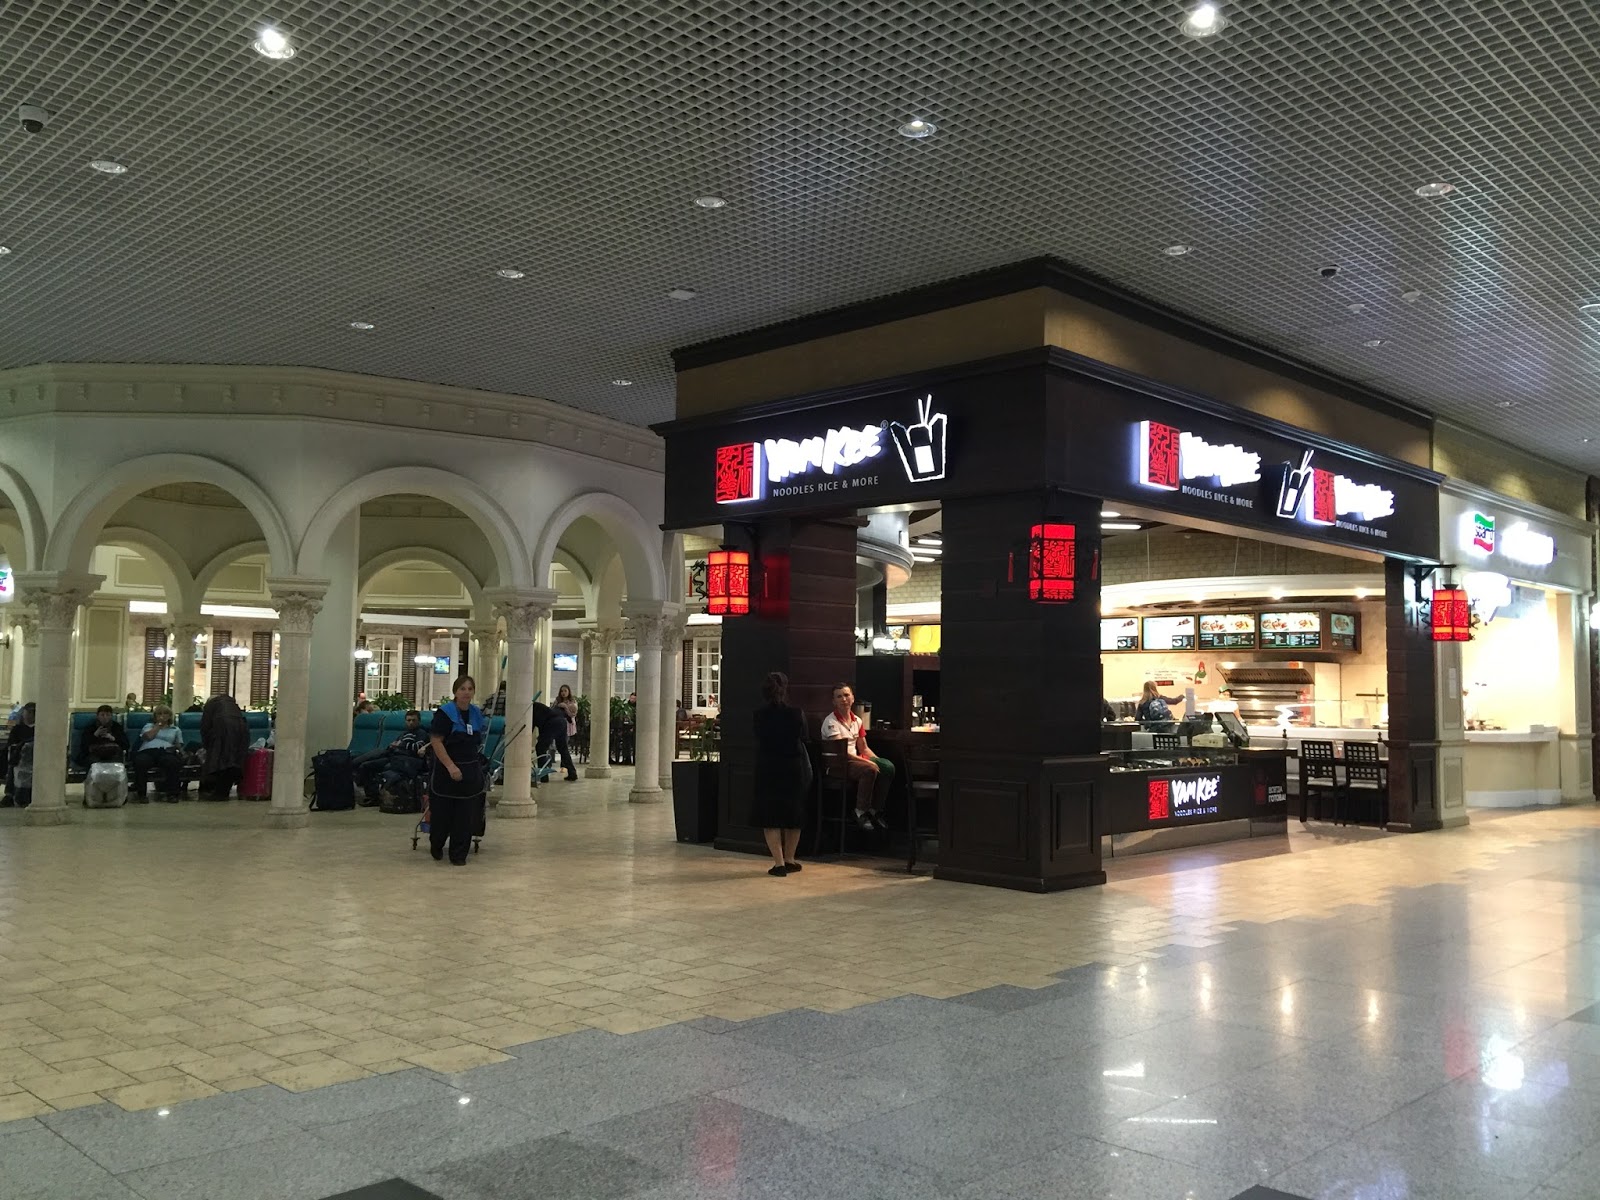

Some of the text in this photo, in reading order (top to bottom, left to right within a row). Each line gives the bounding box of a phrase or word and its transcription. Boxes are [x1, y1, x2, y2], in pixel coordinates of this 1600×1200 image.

[773, 475, 879, 497] NOODLES RICE & MORE
[1182, 485, 1253, 509] NOODLES RICE & MORE
